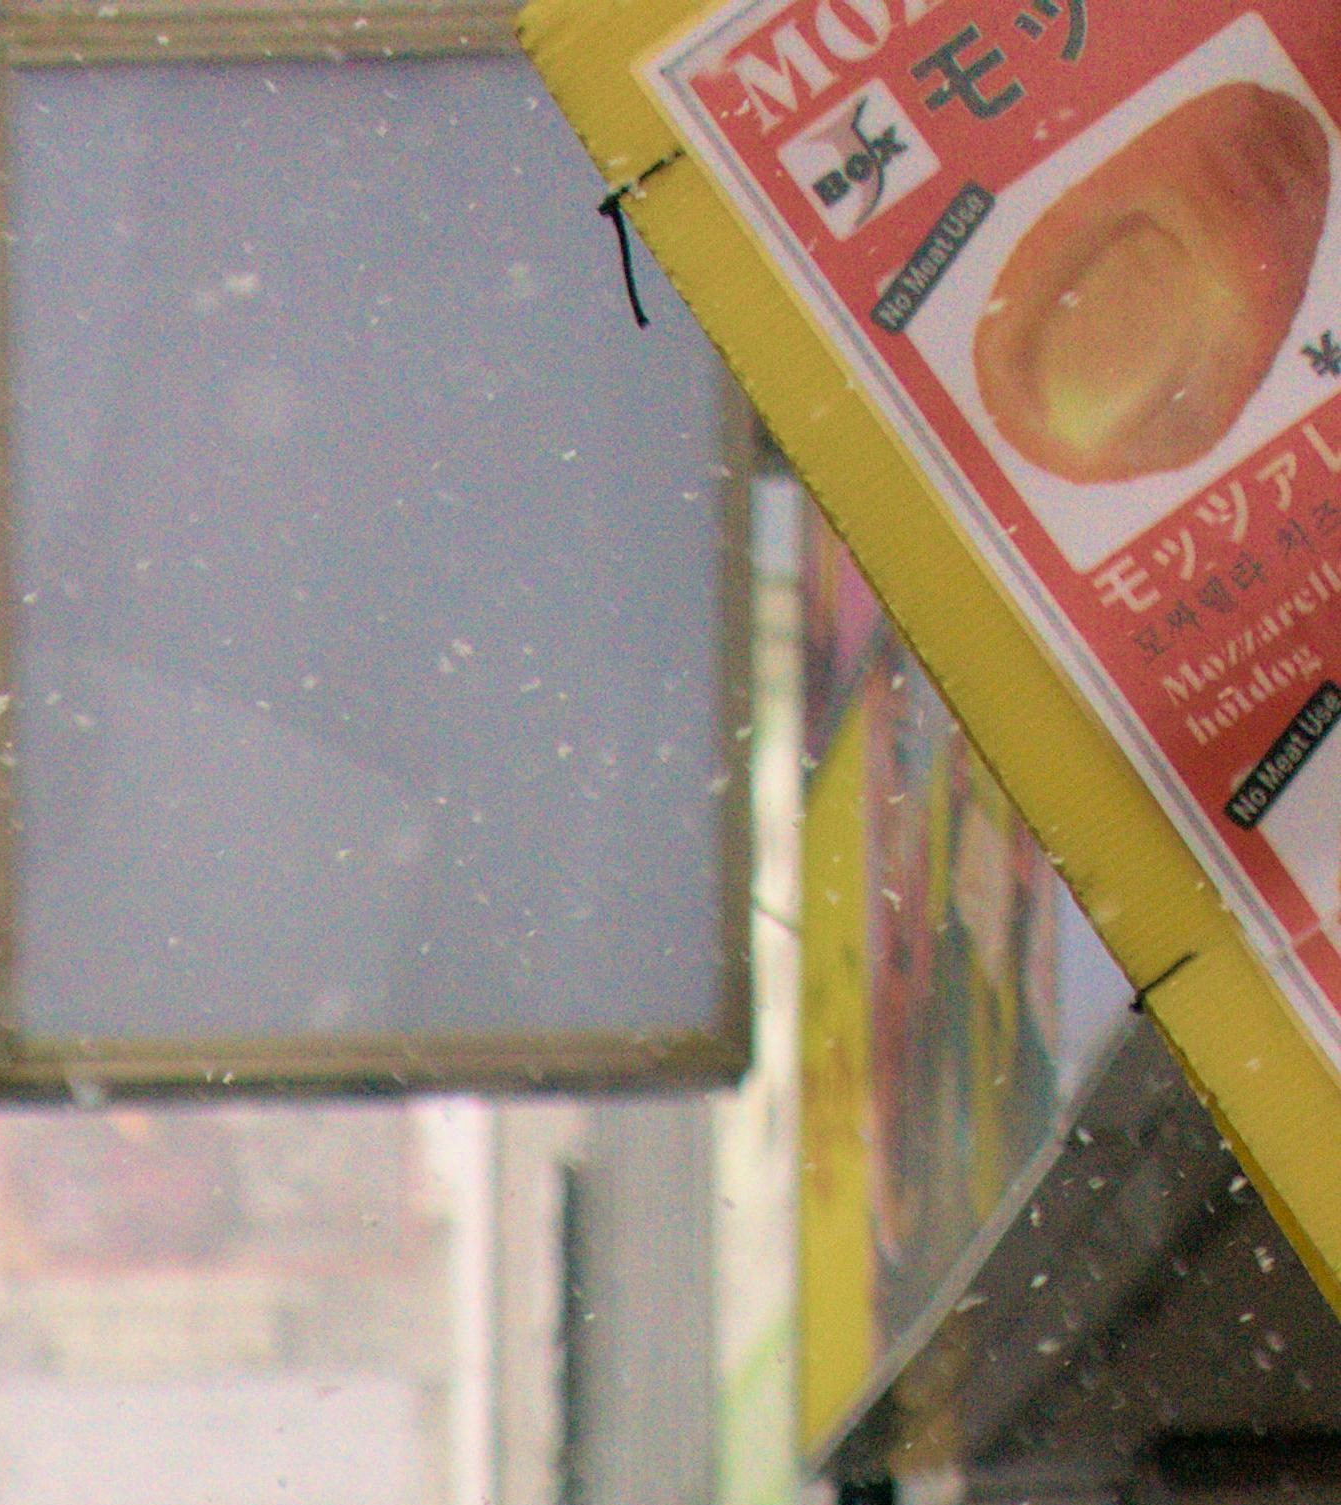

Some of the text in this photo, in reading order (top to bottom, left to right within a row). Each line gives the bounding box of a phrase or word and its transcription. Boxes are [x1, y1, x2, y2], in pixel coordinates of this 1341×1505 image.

[732, 0, 939, 134] MO
[1162, 560, 1341, 706] Mozzarell
[1185, 643, 1323, 746] hotdog
[1231, 789, 1265, 822] No
